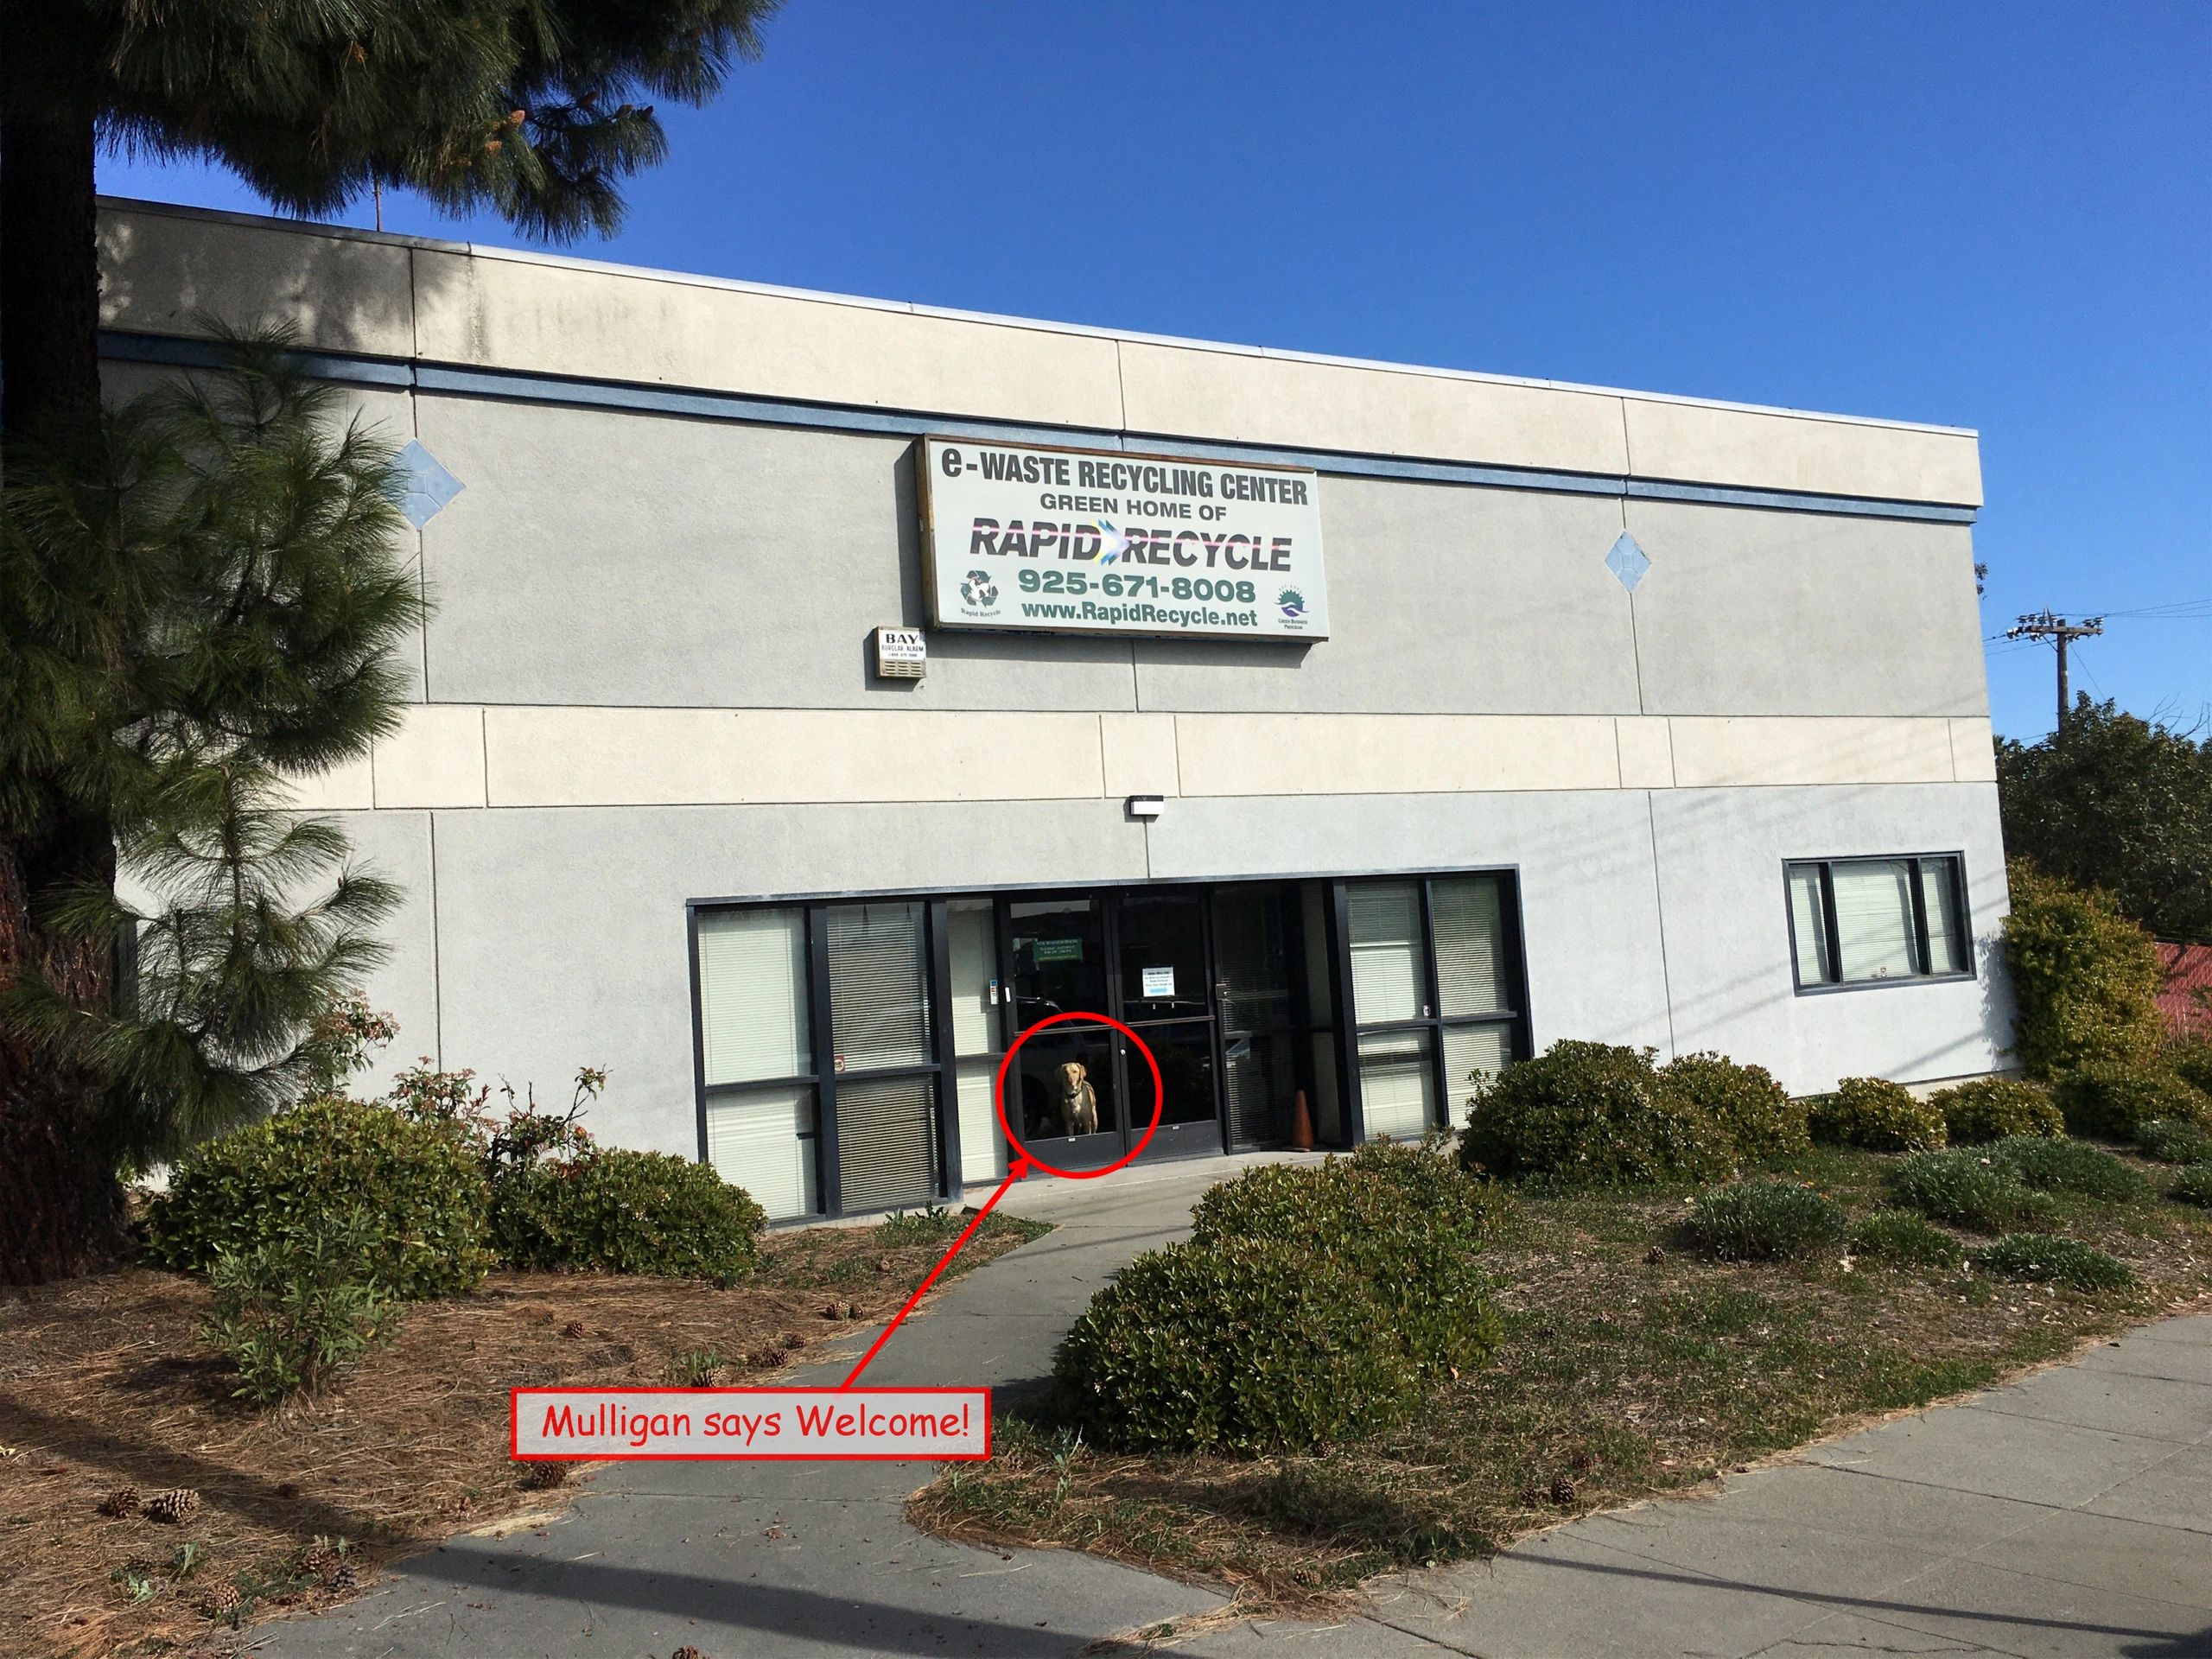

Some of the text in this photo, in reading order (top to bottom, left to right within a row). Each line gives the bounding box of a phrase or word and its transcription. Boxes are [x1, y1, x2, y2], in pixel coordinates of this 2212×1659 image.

[942, 448, 1308, 505] e-WASTE RECYCLING CENTER
[1040, 493, 1227, 521] GREEN HOME OF
[969, 518, 1293, 572] RAPID RECYCLE
[1018, 569, 1256, 603] 925-671-8008
[1021, 601, 1258, 627] www.RapidRecycle.net
[886, 633, 918, 645] BAY
